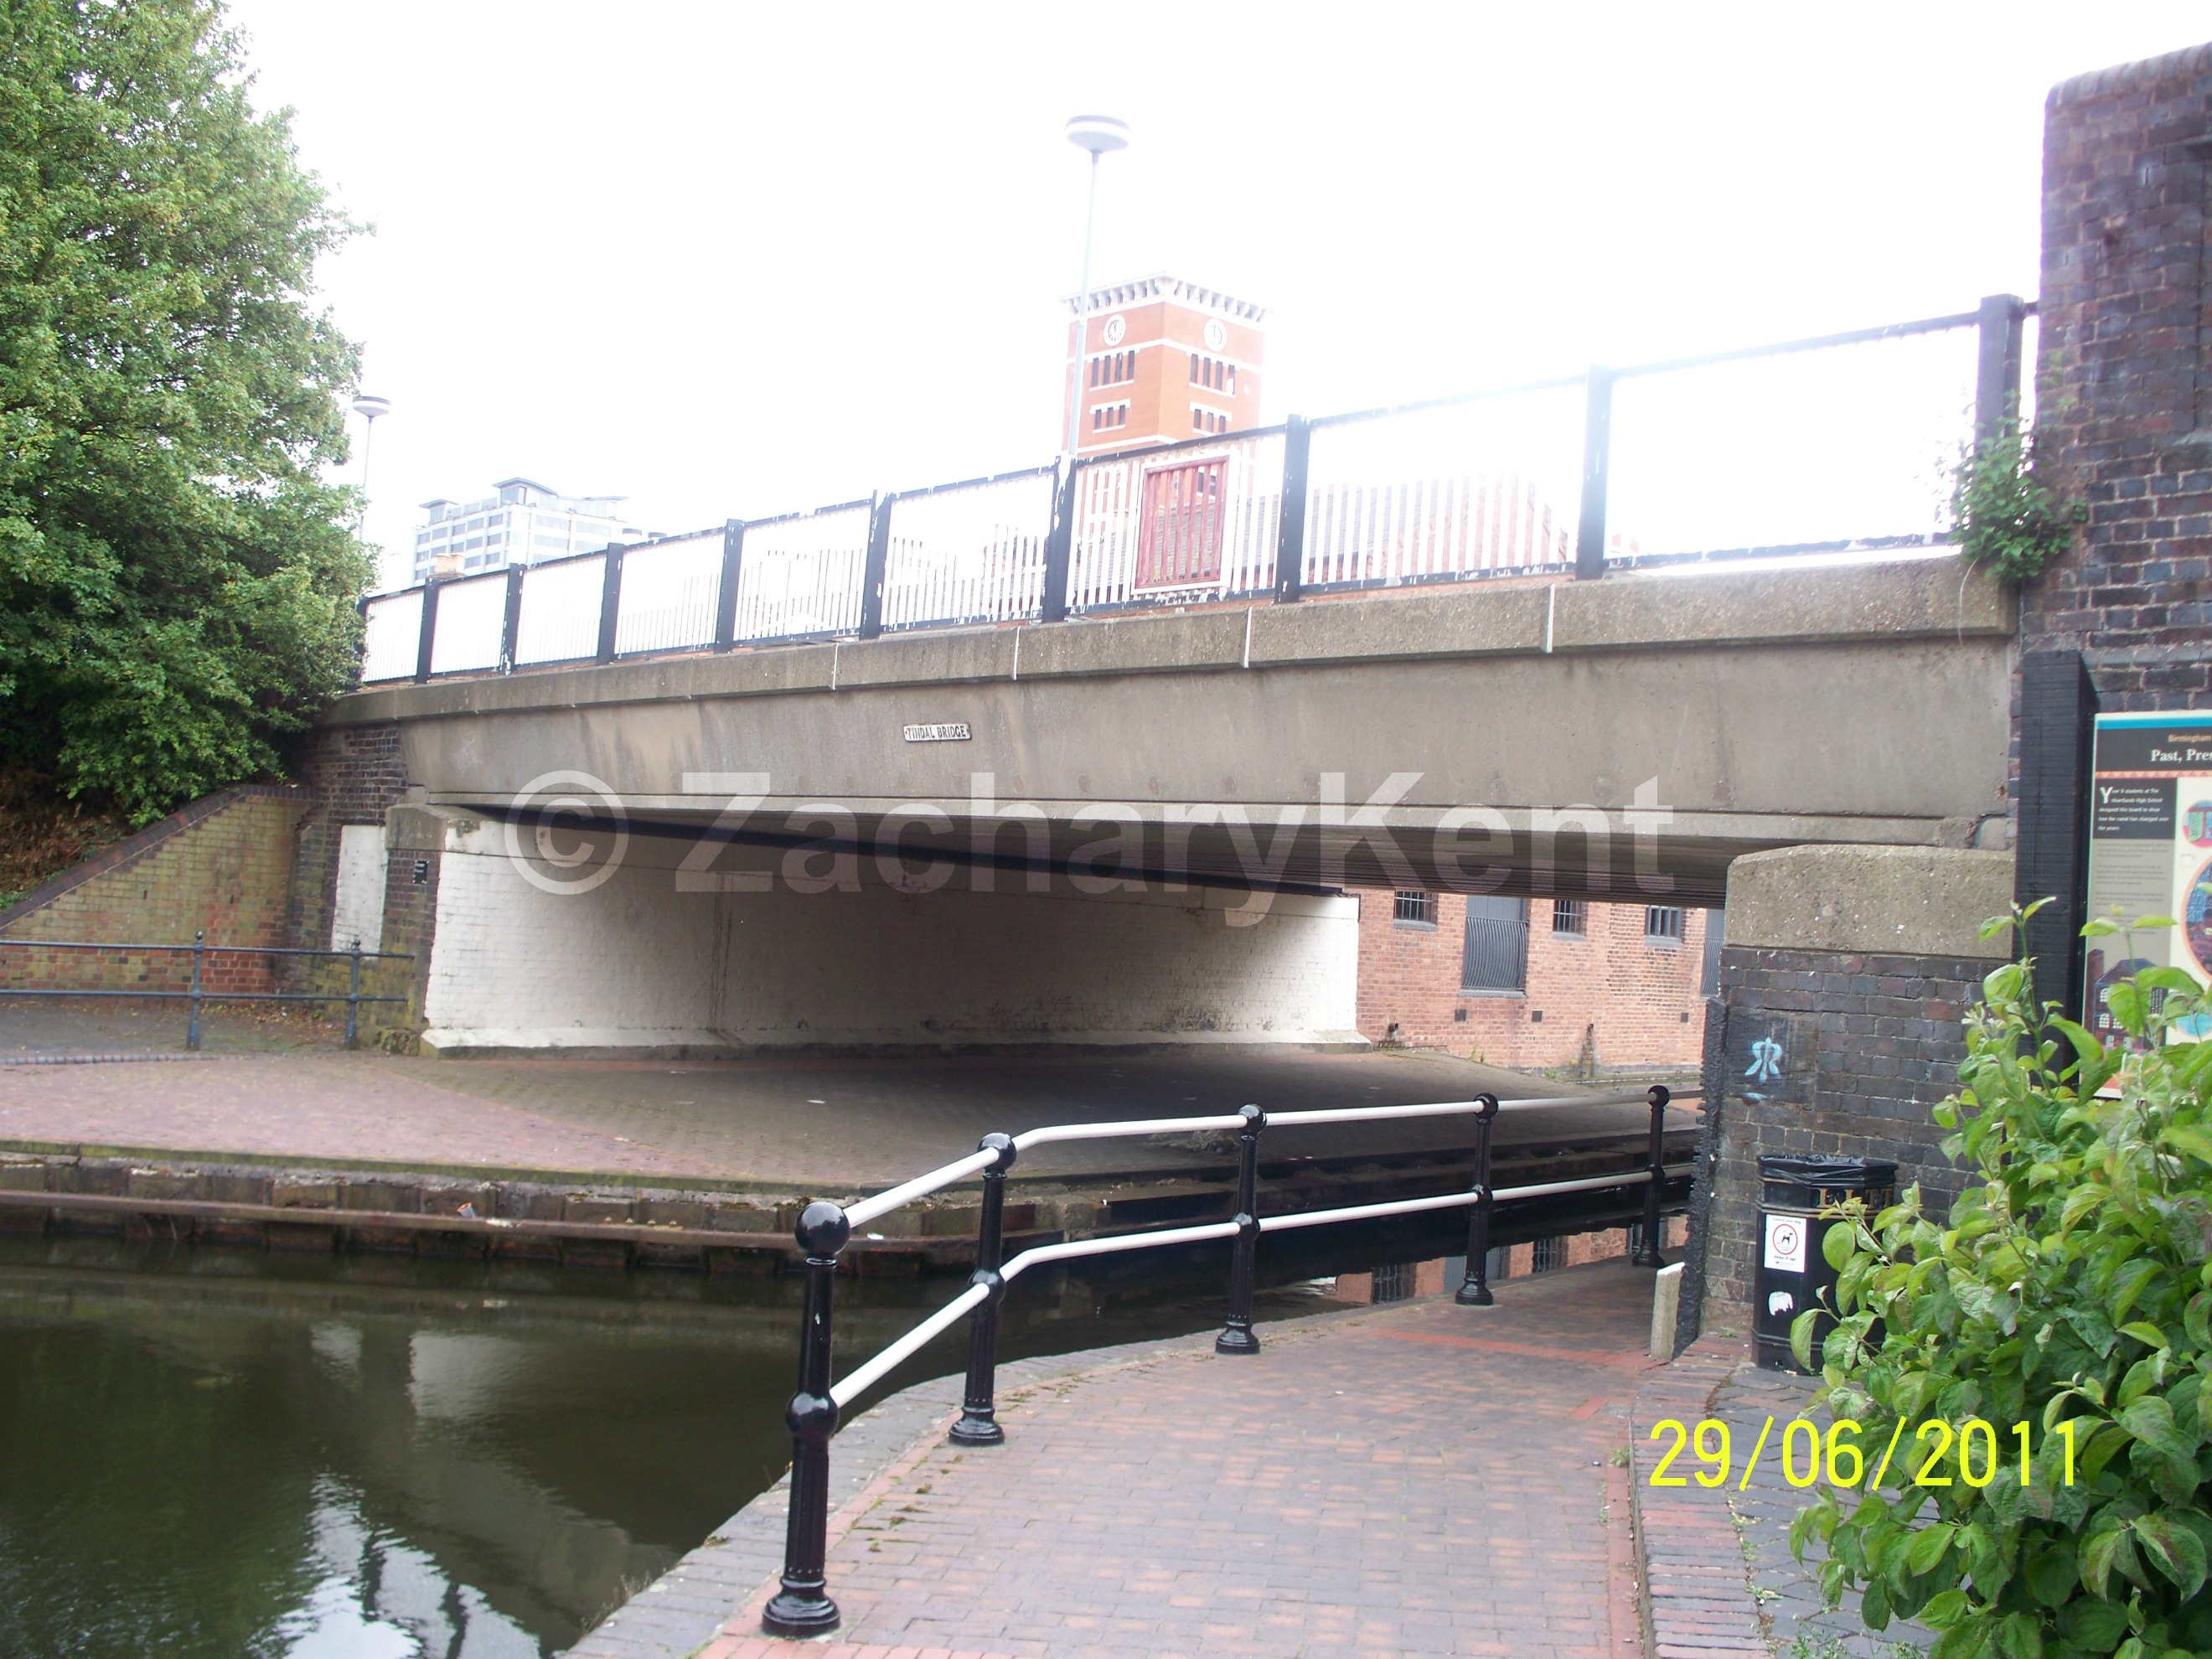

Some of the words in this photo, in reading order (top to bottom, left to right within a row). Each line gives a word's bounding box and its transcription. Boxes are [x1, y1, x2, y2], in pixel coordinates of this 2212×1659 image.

[907, 726, 935, 739] TINDAL
[937, 726, 966, 737] BRIDGE
[2168, 734, 2212, 743] Birmingham
[2150, 749, 2183, 763] Past,
